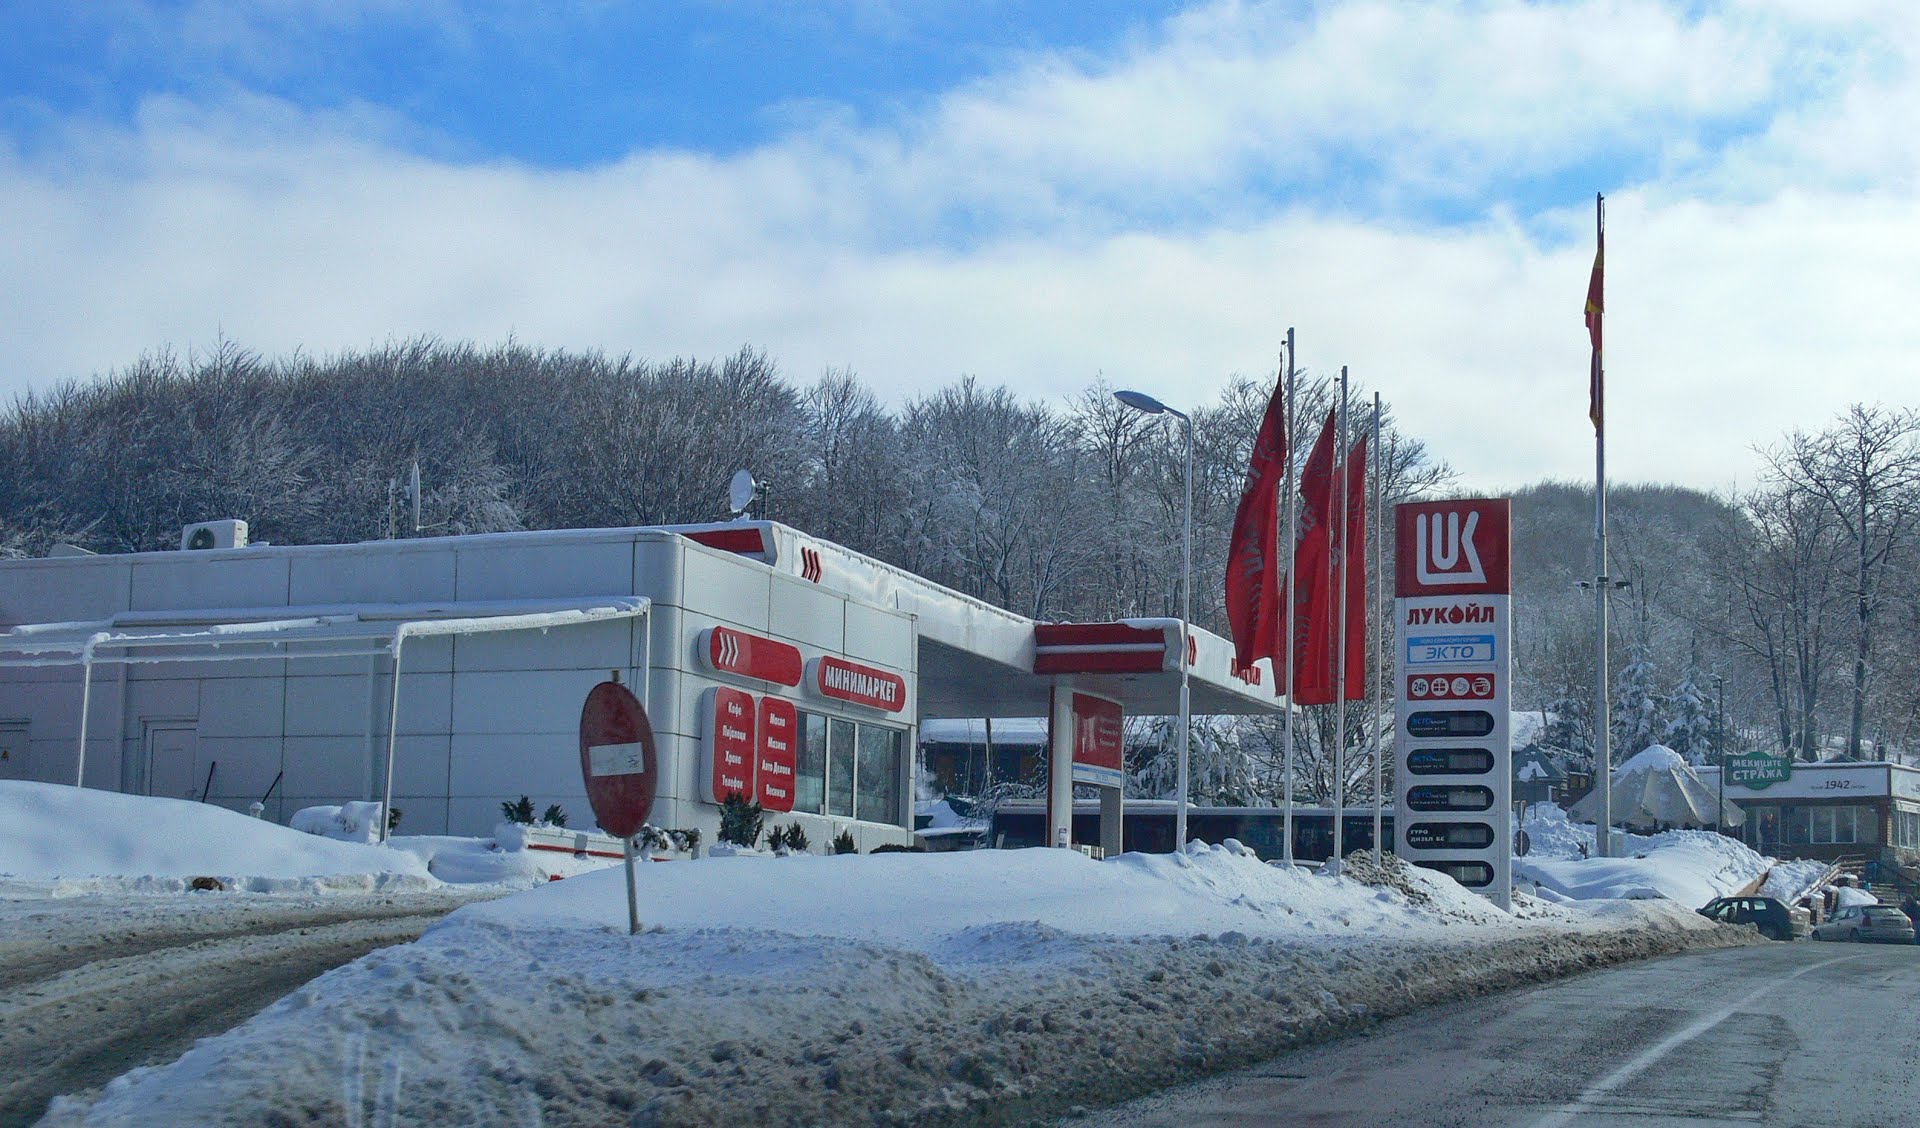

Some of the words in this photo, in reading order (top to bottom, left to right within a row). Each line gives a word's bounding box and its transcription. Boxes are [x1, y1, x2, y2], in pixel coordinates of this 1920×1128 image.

[1426, 645, 1474, 660] ЭКТО
[824, 665, 897, 703] МИНИМАРКЕТ
[1413, 681, 1427, 692] 24h
[1732, 768, 1783, 781] СТРАЖА
[1824, 780, 1850, 790] 1942
